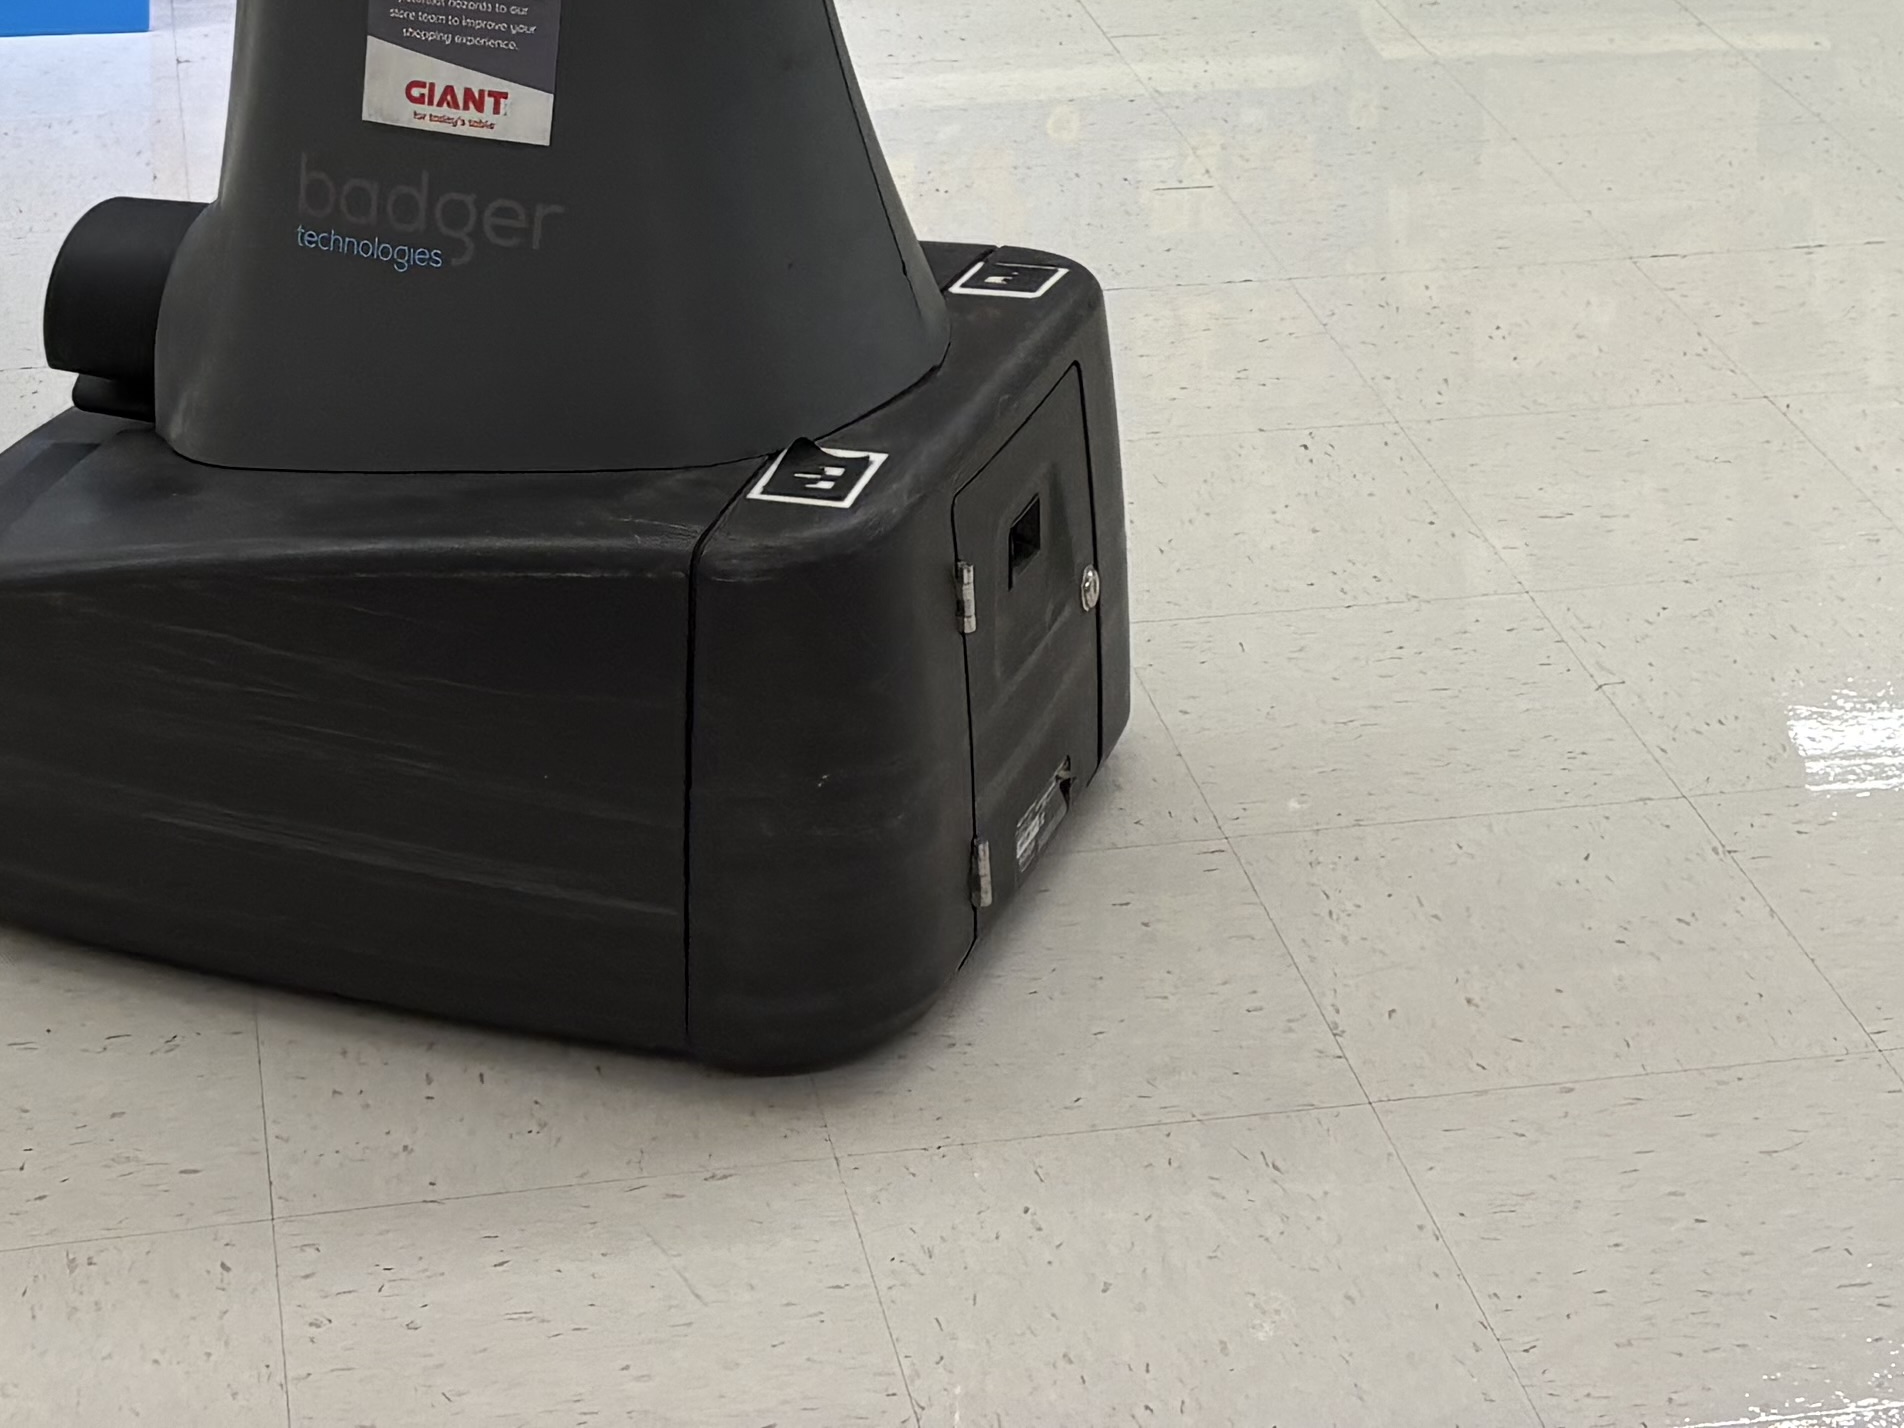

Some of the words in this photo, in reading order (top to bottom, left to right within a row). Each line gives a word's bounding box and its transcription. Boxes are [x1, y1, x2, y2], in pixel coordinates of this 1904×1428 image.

[404, 79, 508, 115] GIANT
[298, 152, 565, 265] badger
[296, 224, 443, 272] technologies
